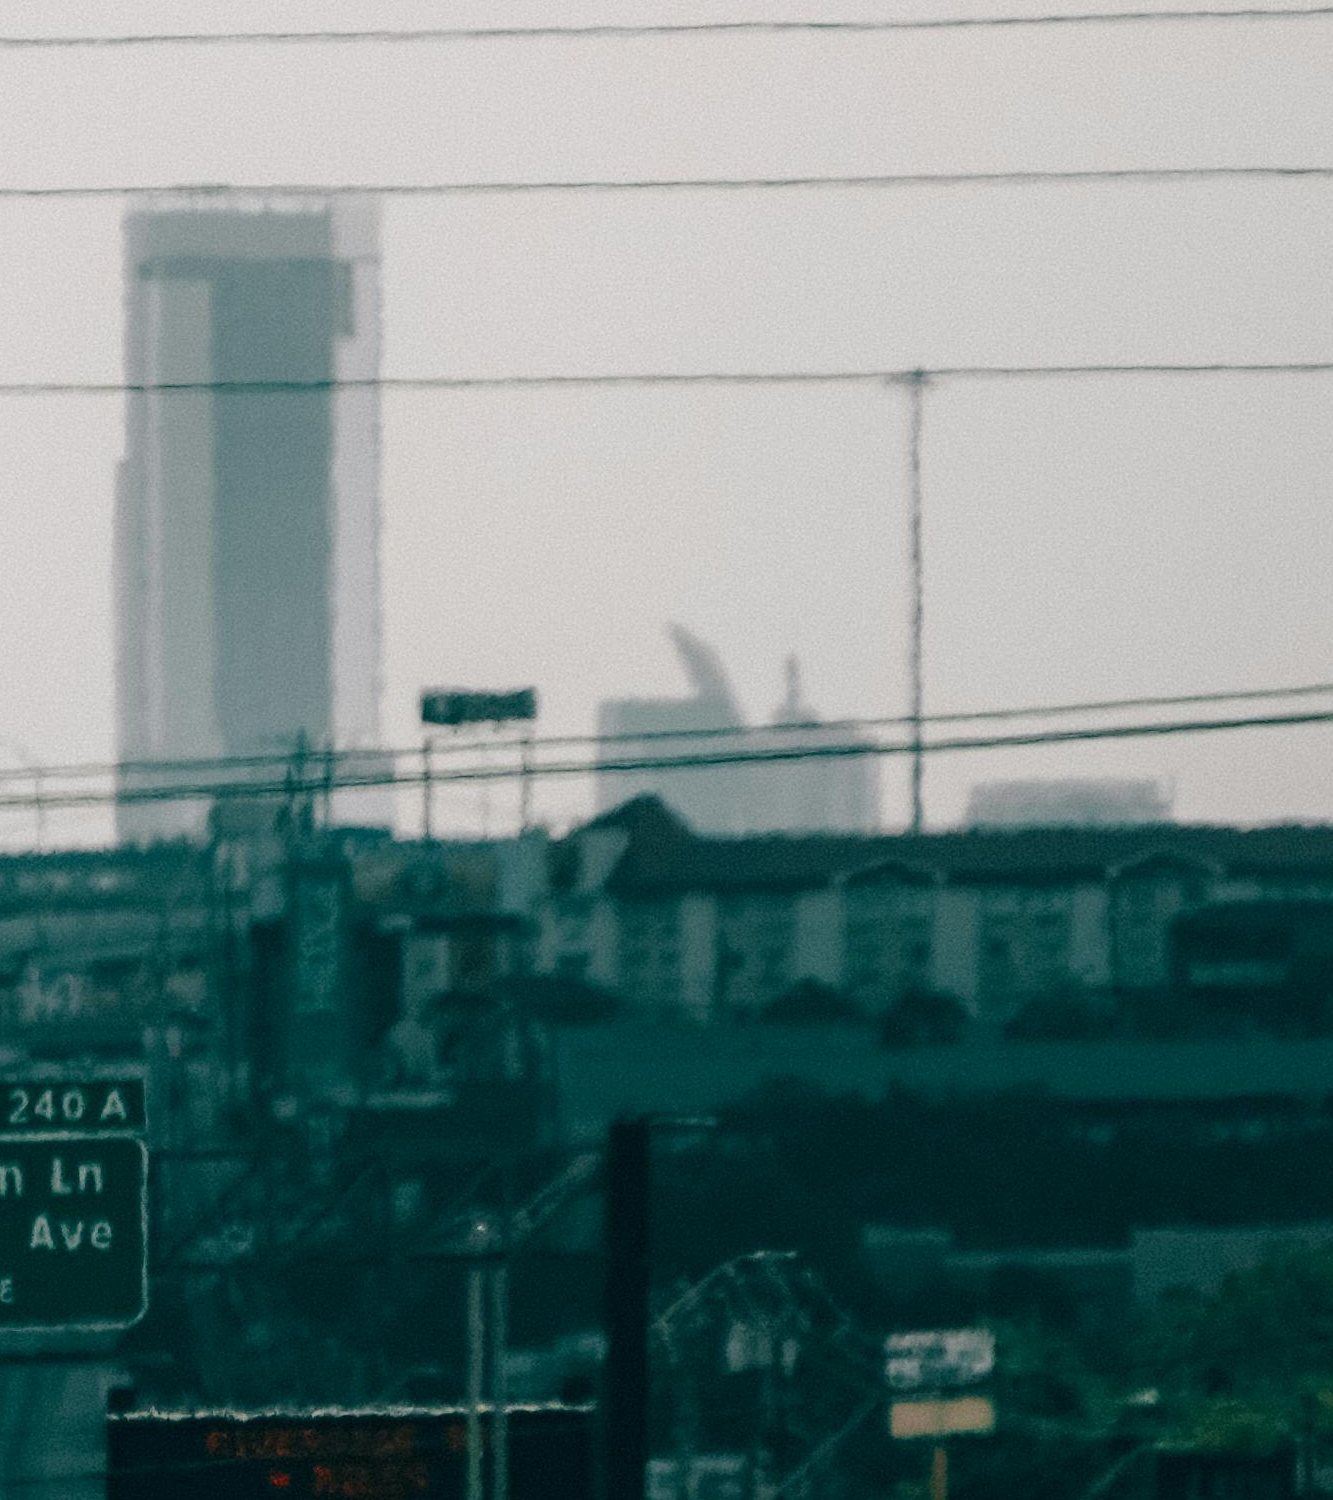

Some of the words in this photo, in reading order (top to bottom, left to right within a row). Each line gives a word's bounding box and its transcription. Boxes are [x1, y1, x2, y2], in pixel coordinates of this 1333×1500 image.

[9, 1089, 86, 1123] 240
[101, 1089, 126, 1121] A
[51, 1158, 103, 1195] Ln
[30, 1212, 113, 1252] Ave
